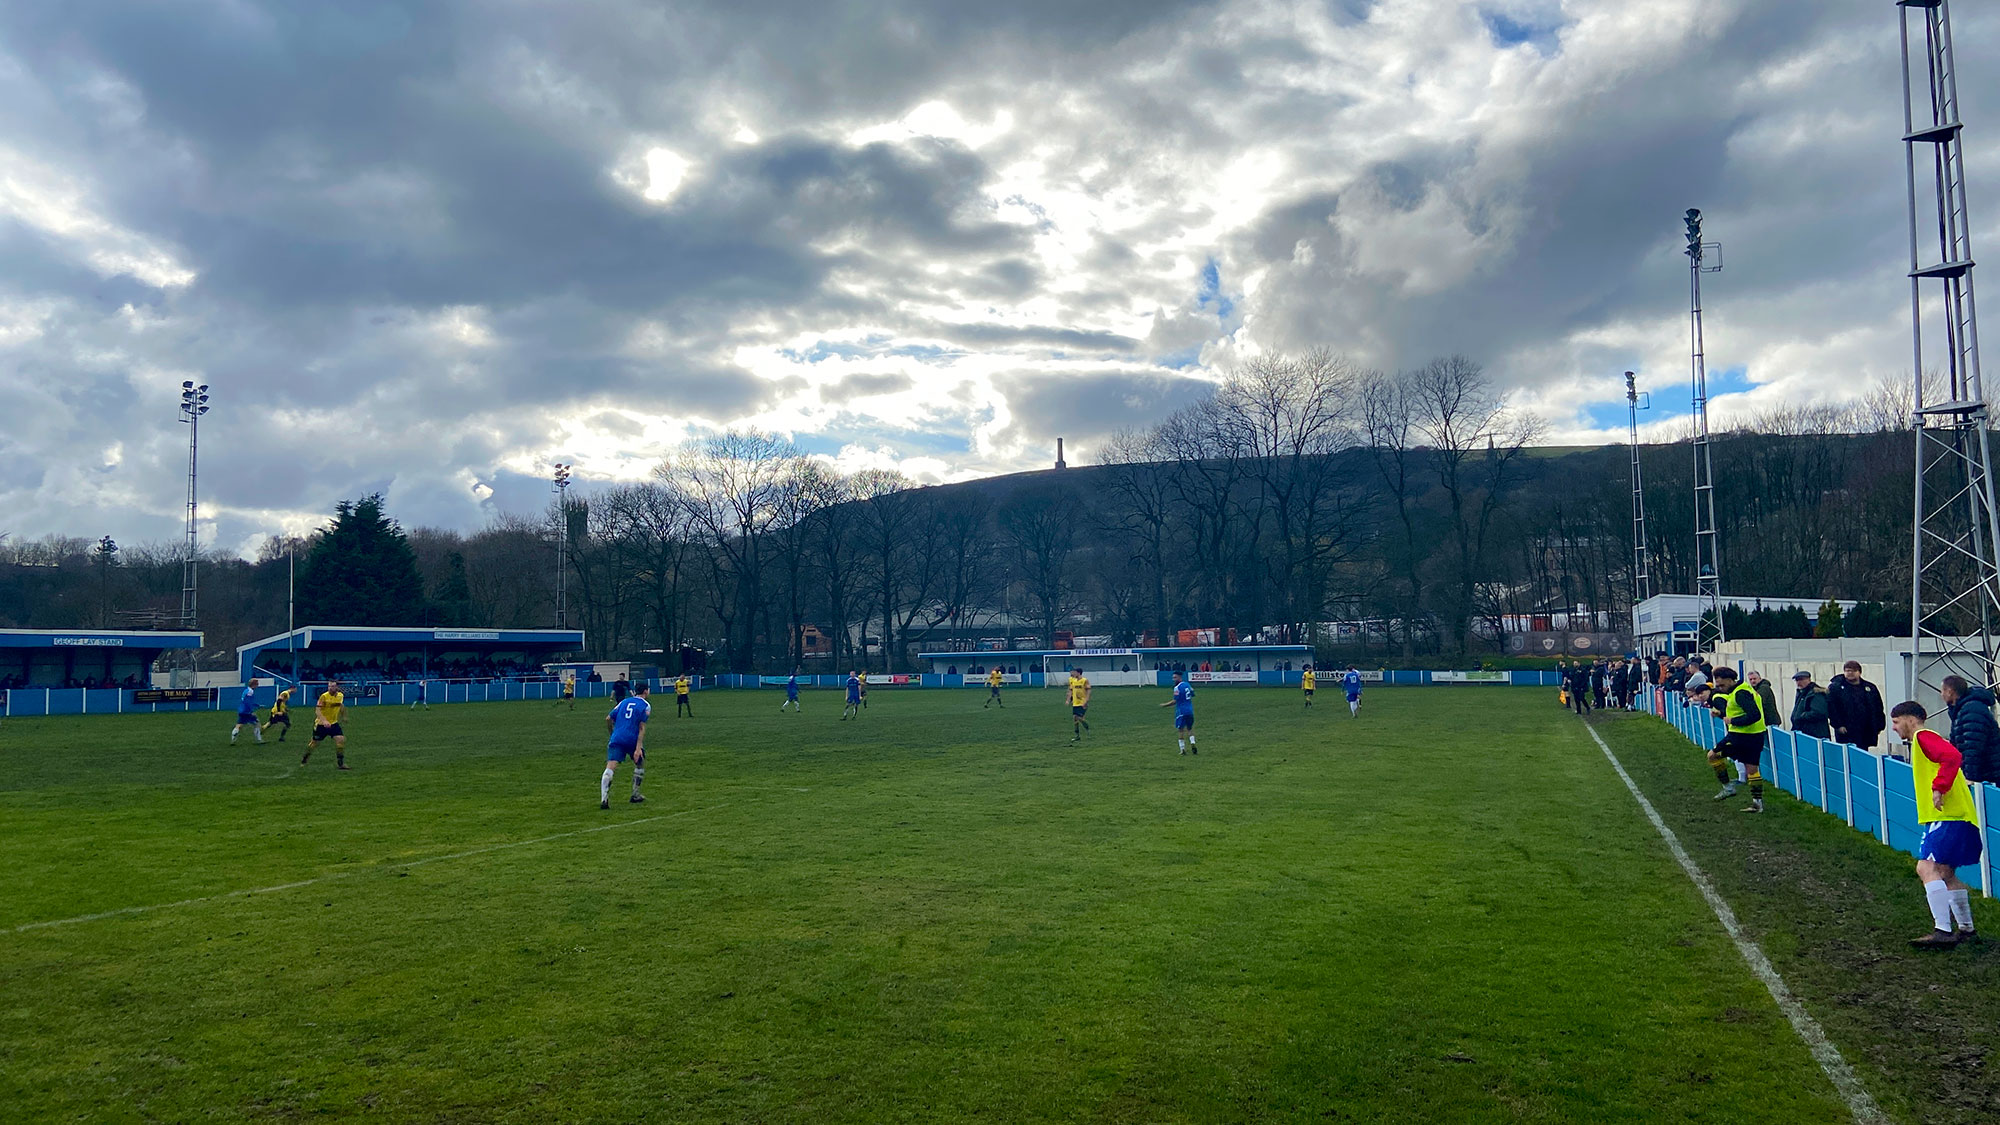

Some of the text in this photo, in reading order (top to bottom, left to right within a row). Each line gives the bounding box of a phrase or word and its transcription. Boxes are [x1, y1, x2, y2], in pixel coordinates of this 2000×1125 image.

[55, 638, 122, 646] GEOFF LAY STAND
[1315, 671, 1346, 679] Hillsto
[1349, 675, 1357, 684] 10
[1185, 687, 1191, 700] 2
[625, 702, 636, 719] 5
